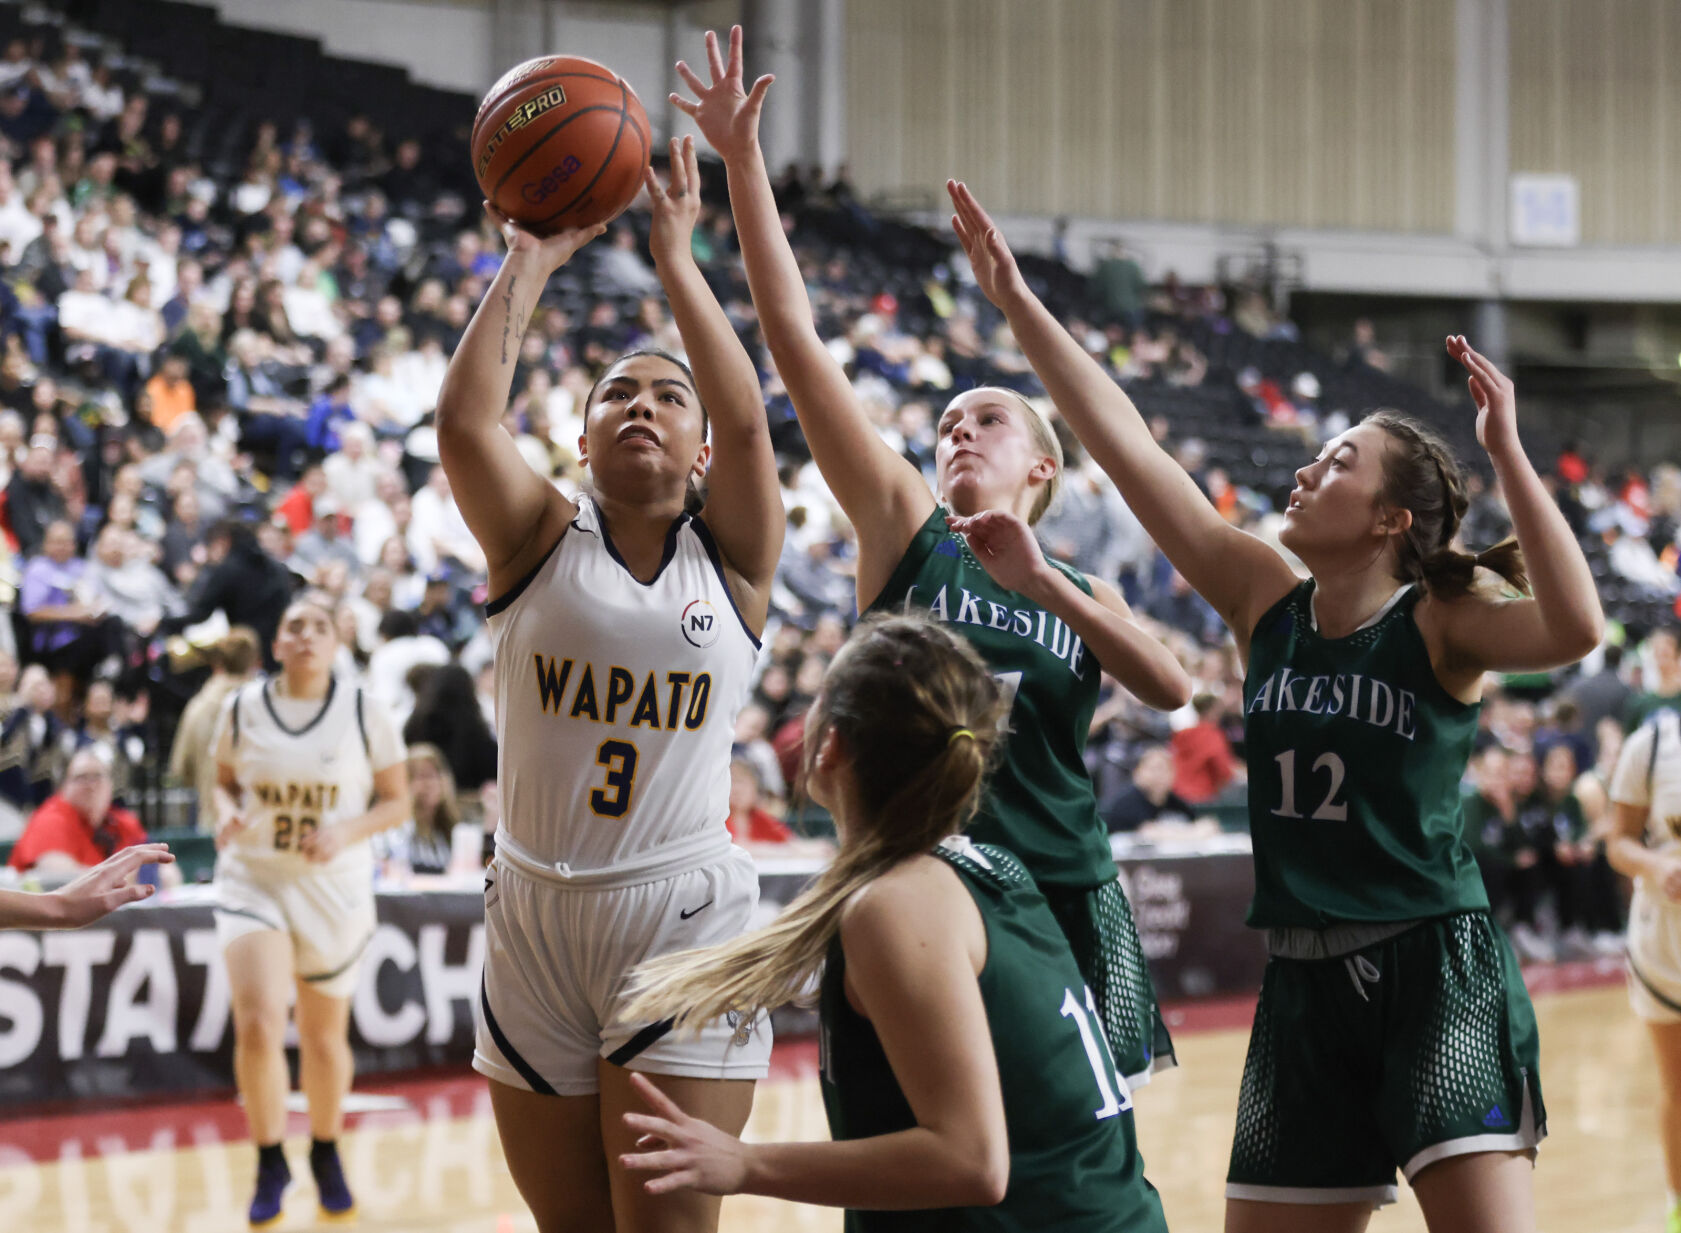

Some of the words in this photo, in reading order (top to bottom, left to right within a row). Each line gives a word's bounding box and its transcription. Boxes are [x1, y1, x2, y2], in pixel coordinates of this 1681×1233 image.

[478, 106, 528, 179] ELITE
[522, 85, 565, 122] PRO
[521, 154, 582, 206] Gesa
[690, 614, 714, 632] N7
[533, 652, 713, 733] WAPATO
[1247, 667, 1416, 741] AKESIDE
[587, 736, 641, 821] 3
[1270, 748, 1348, 823] 12
[0, 927, 298, 1069] STAT
